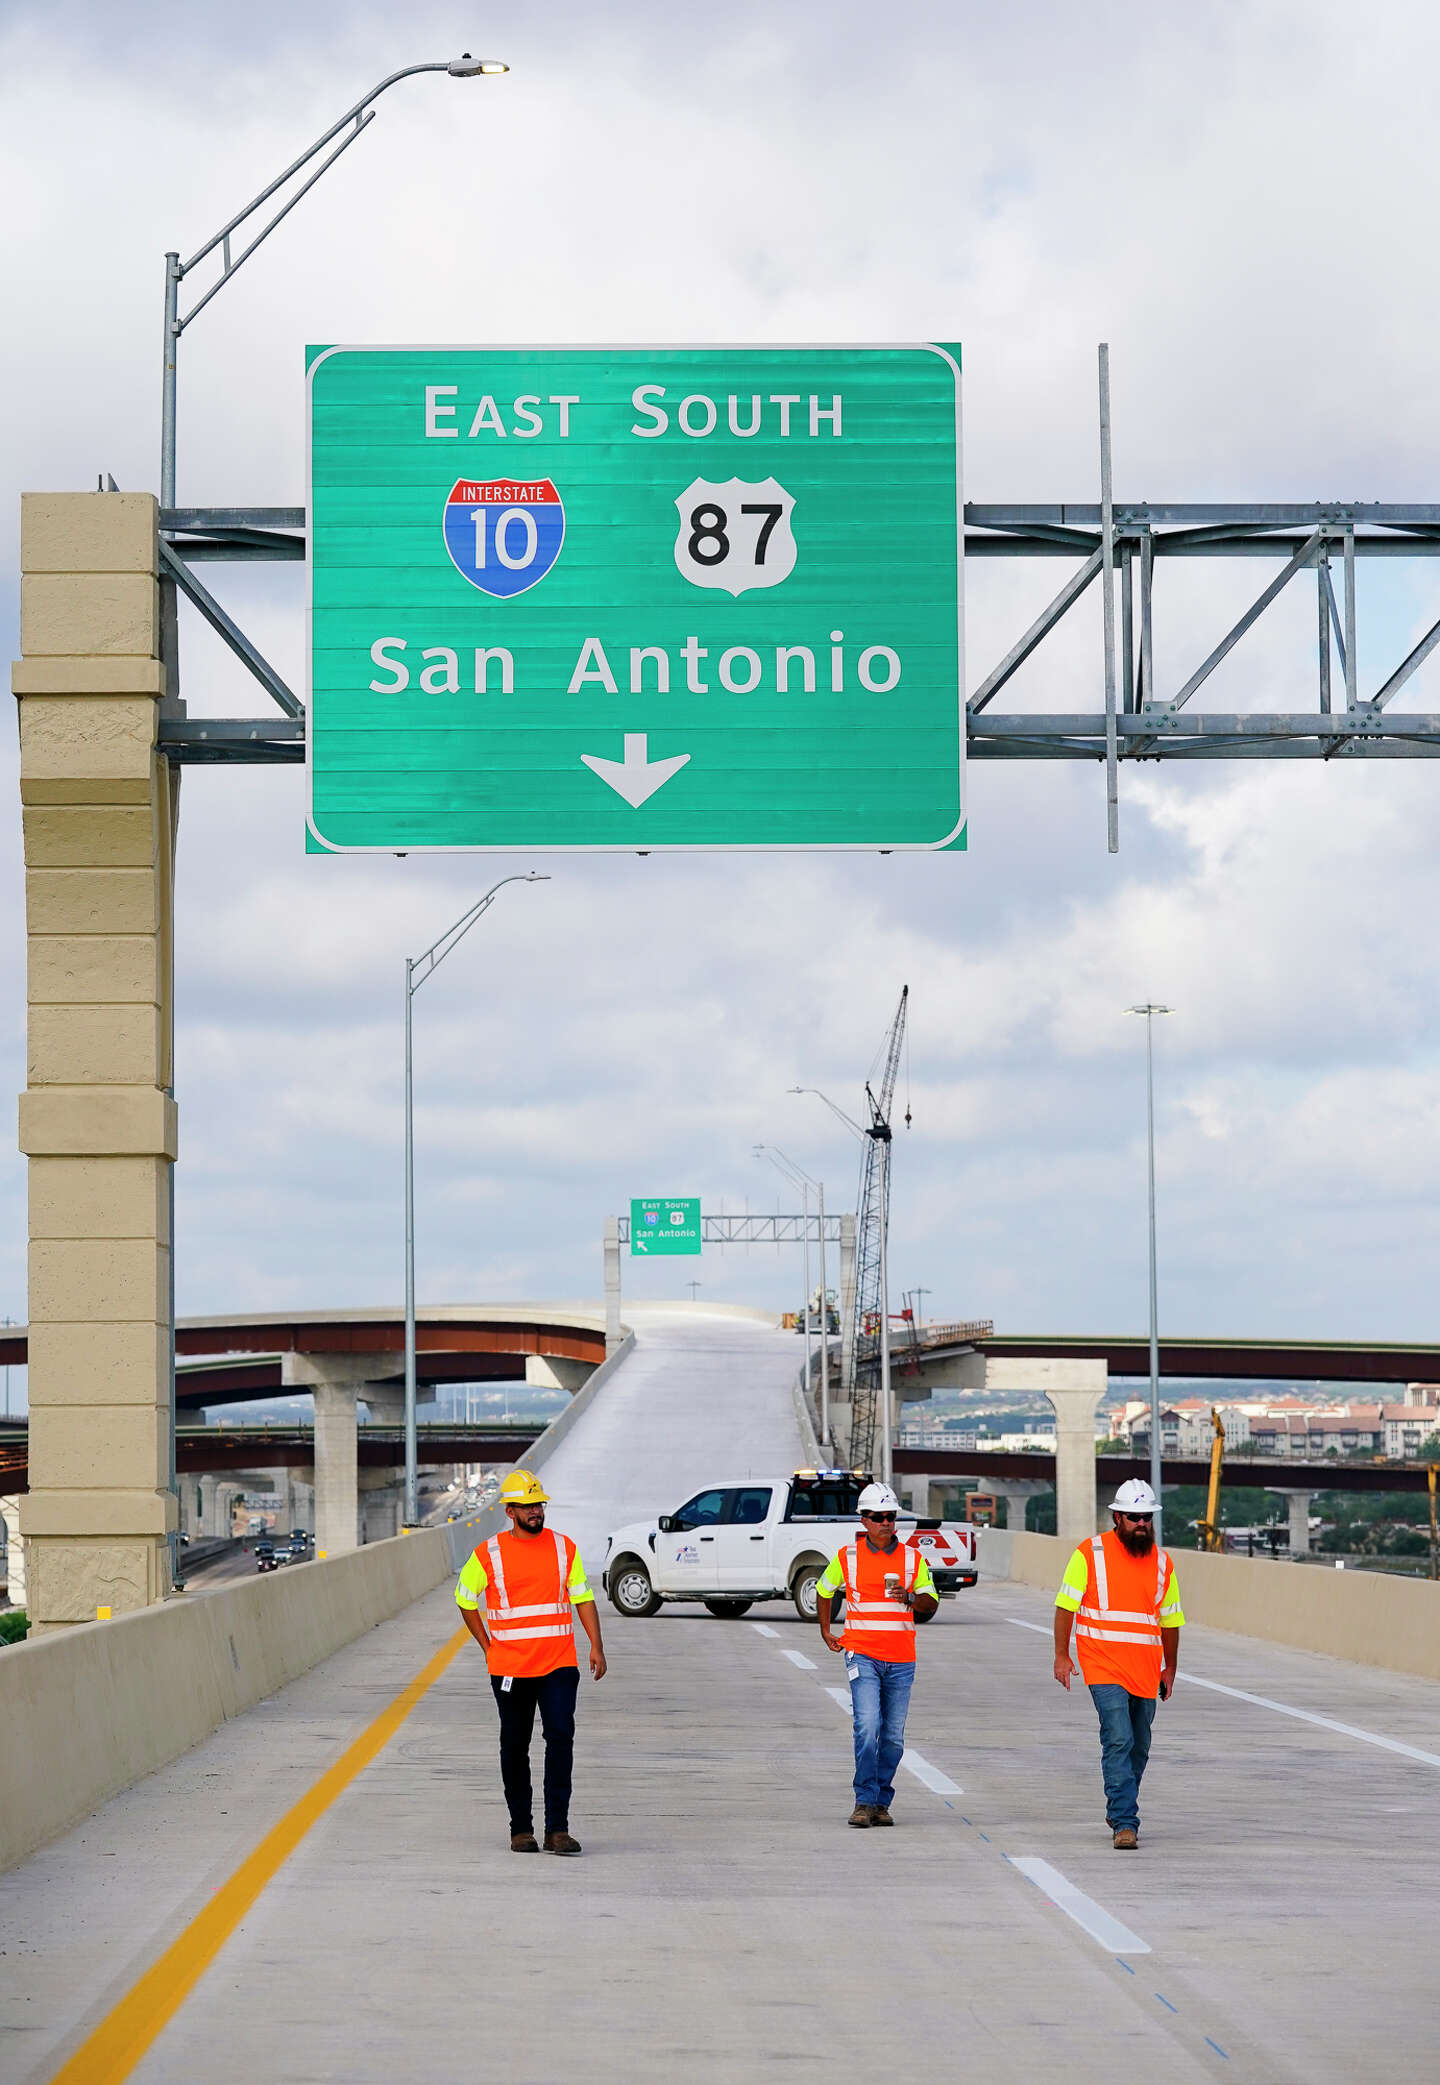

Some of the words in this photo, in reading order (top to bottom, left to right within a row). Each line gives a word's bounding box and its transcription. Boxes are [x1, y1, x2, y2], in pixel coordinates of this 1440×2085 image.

[424, 385, 580, 438] EAST
[630, 384, 844, 438] SOUTH
[462, 486, 545, 502] INTERSTATE
[470, 508, 539, 570] 10
[688, 503, 783, 567] 87
[368, 637, 515, 695] San
[567, 630, 903, 695] Antonio
[636, 1230, 654, 1238] San
[658, 1229, 696, 1238] Antonio
